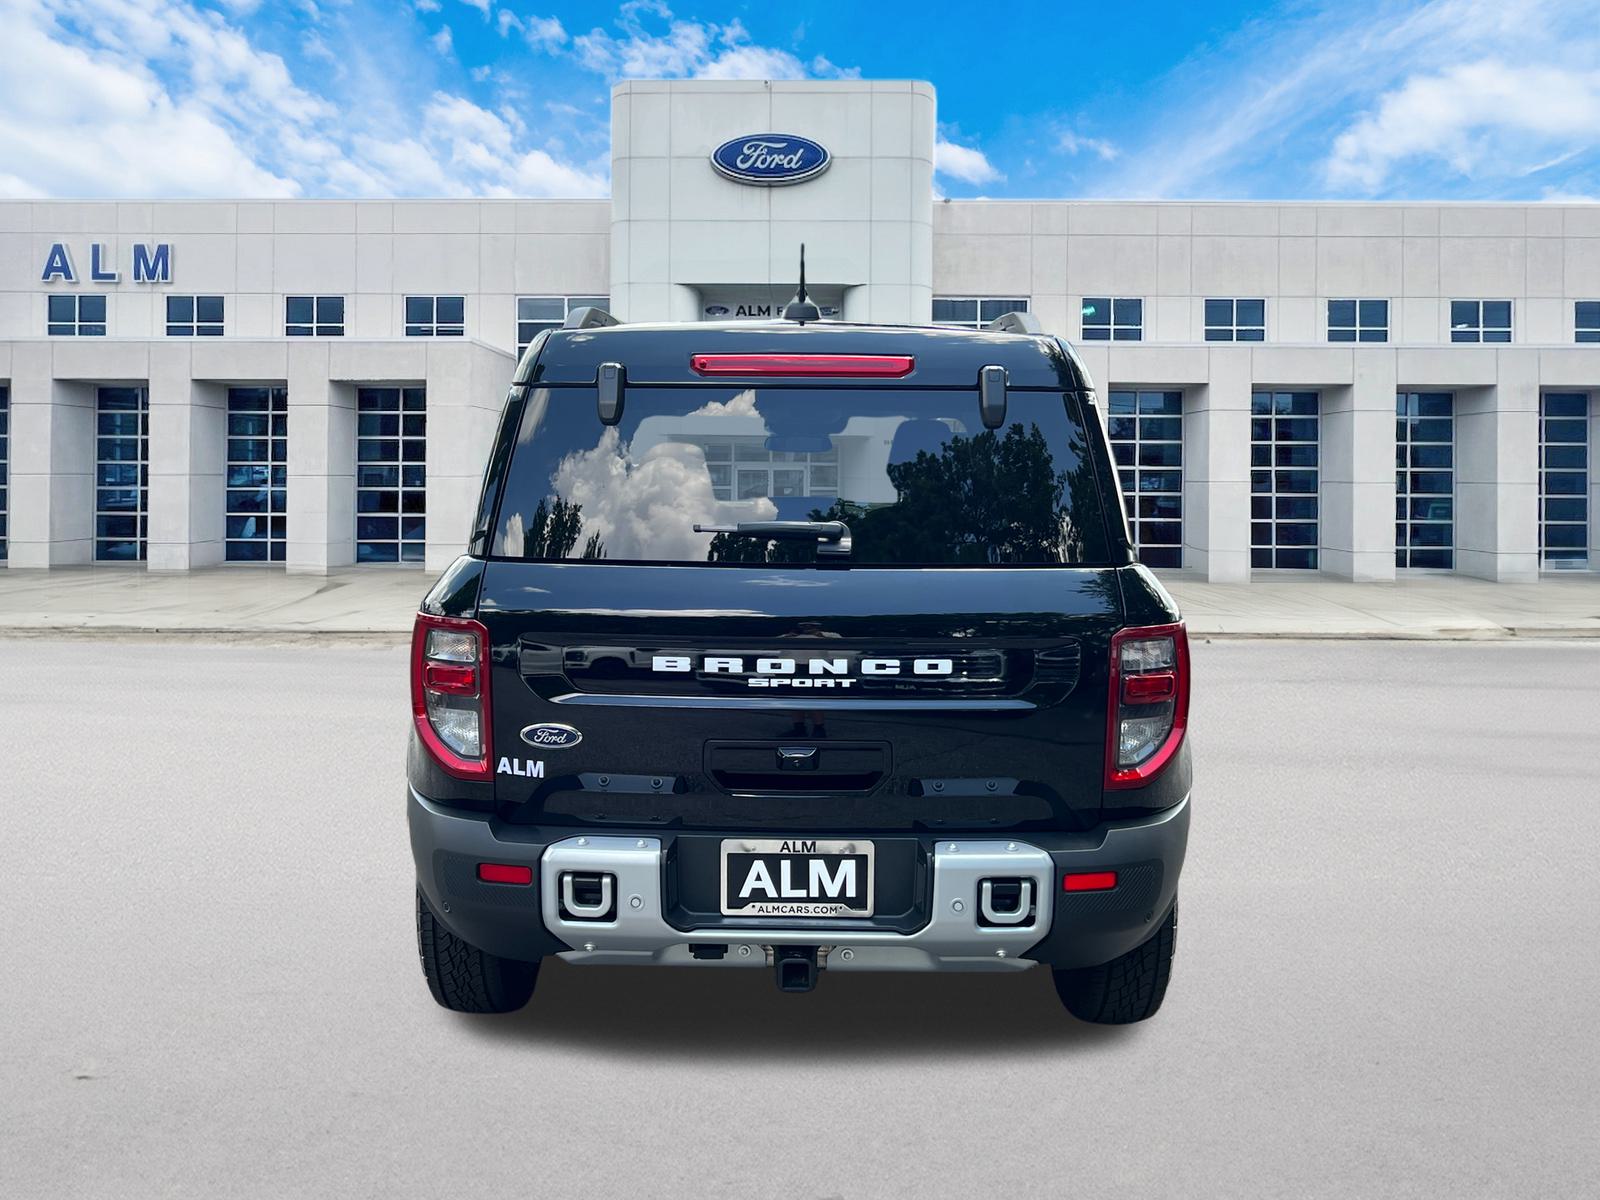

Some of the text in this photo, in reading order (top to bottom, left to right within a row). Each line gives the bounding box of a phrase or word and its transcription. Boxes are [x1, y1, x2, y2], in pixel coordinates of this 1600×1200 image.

[736, 141, 804, 169] Ford
[41, 242, 172, 282] ALM
[736, 305, 771, 317] ALM
[652, 656, 953, 675] BRONCO
[748, 678, 857, 688] SPORT
[533, 728, 567, 744] Ford
[496, 756, 544, 778] ALM
[779, 841, 817, 853] ALM
[738, 859, 857, 898] ALM
[757, 905, 838, 914] ALMCARS.COM
